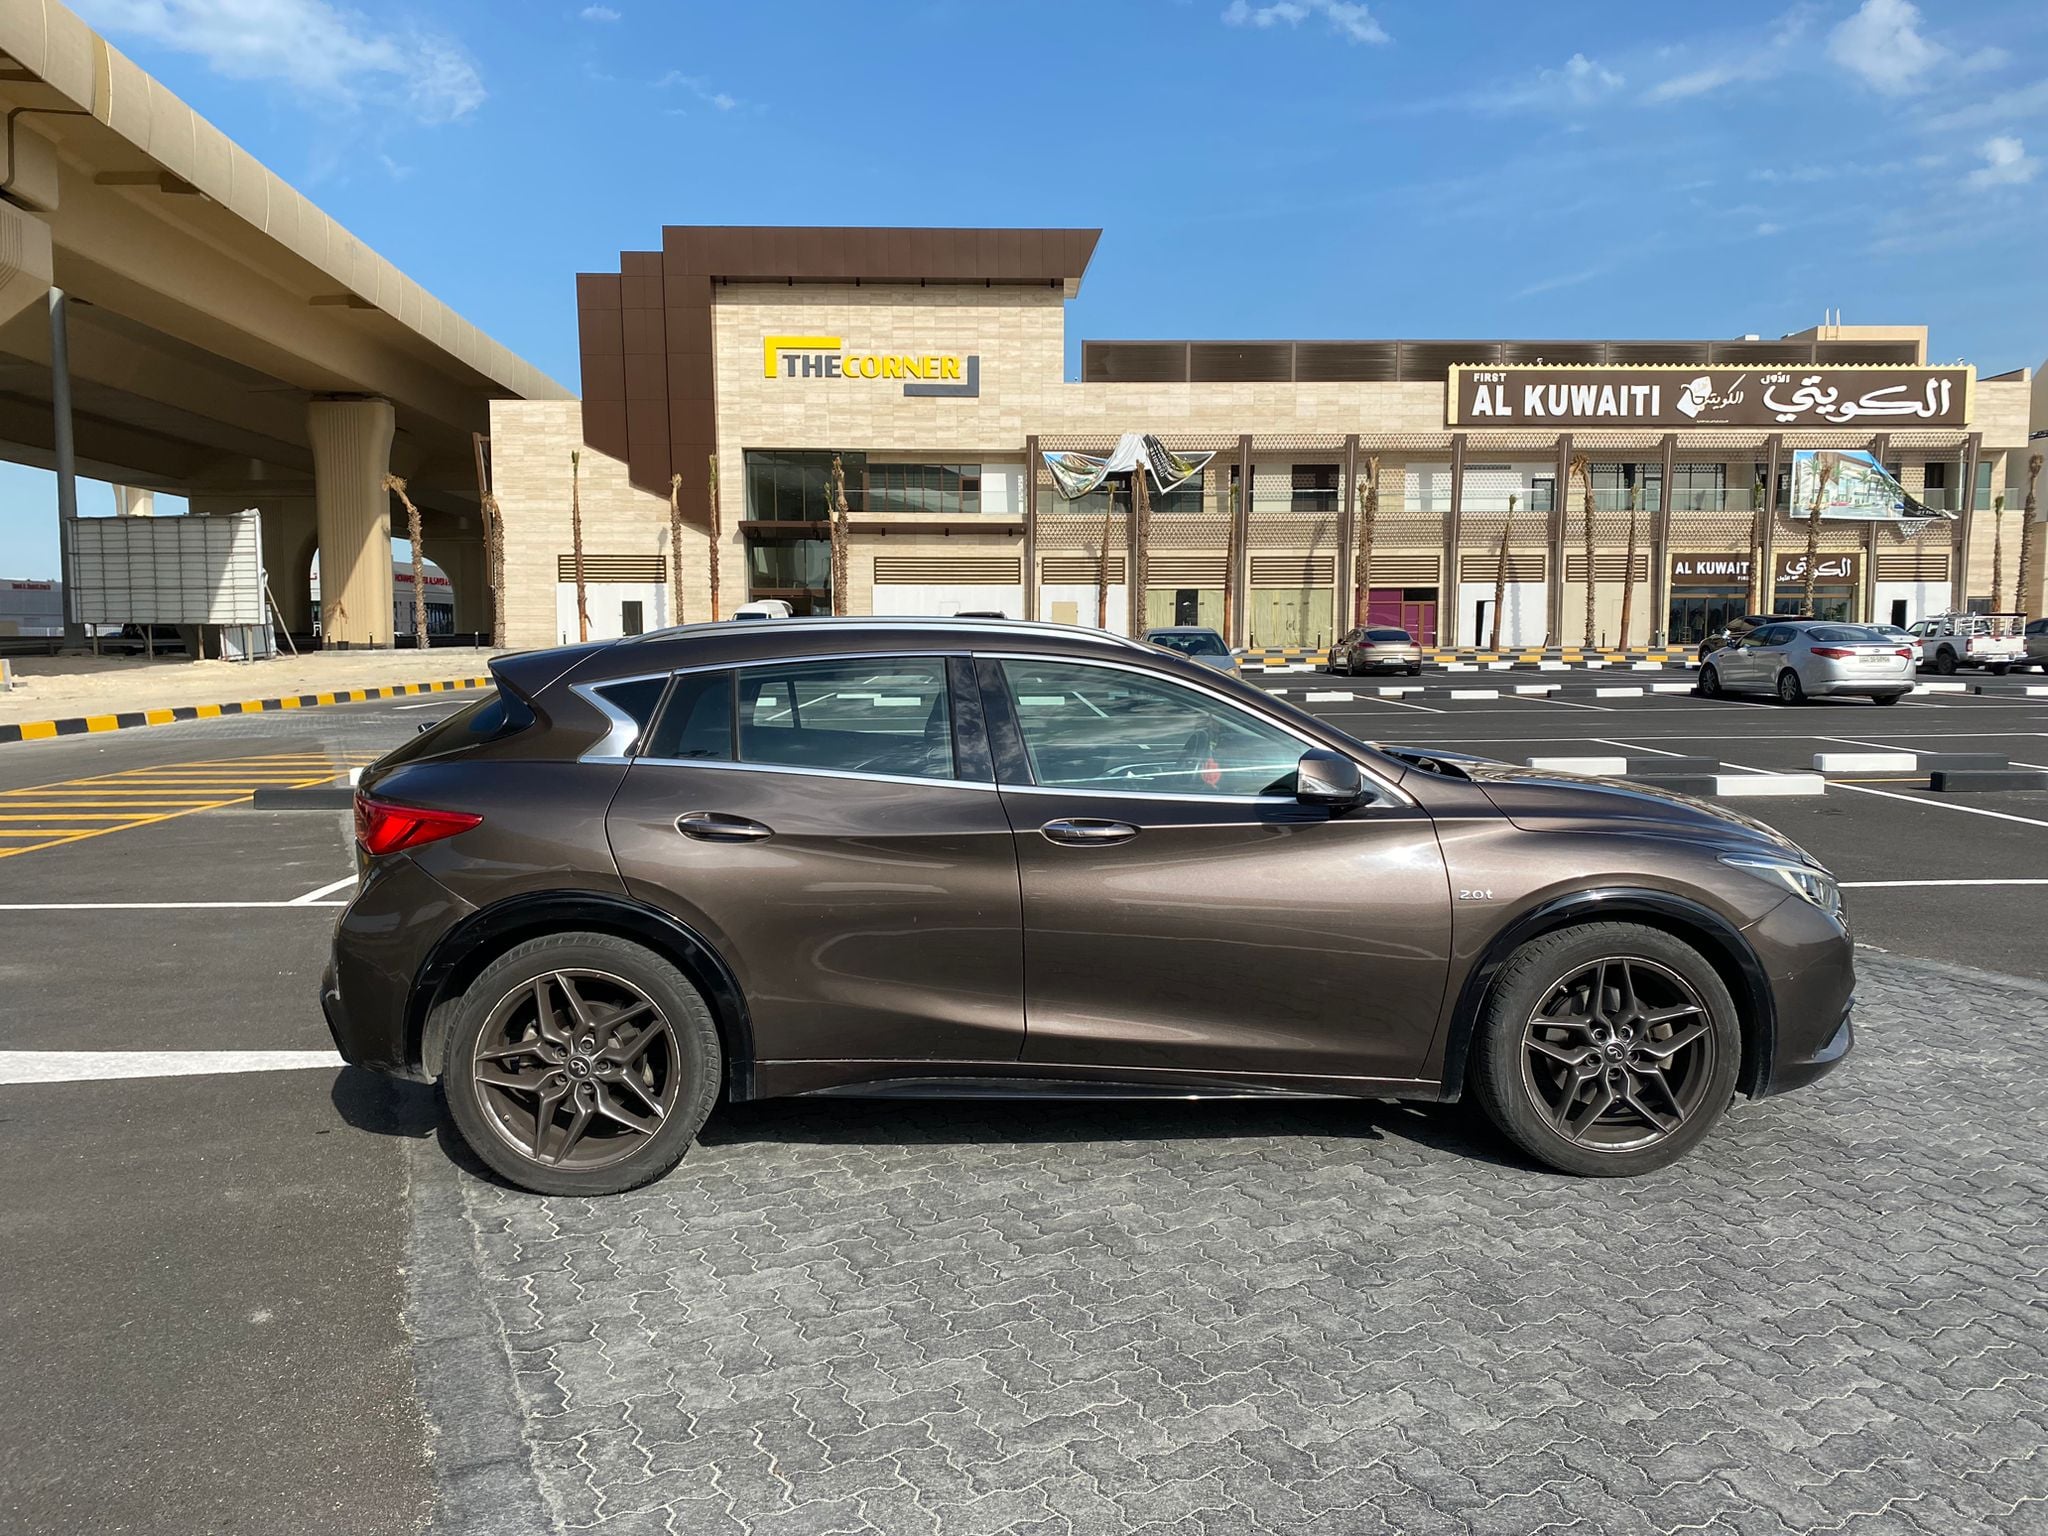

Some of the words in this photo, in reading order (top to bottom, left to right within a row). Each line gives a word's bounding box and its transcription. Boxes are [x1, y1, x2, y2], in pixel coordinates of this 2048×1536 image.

[782, 354, 841, 377] THE
[841, 354, 961, 379] CORNER
[1473, 372, 1506, 383] FIRST
[1471, 384, 1513, 416] AL
[1524, 384, 1661, 417] KUWAITI
[1763, 374, 1952, 423] الكويتي
[1675, 561, 1693, 575] AL
[1696, 561, 1751, 575] KUWAIT
